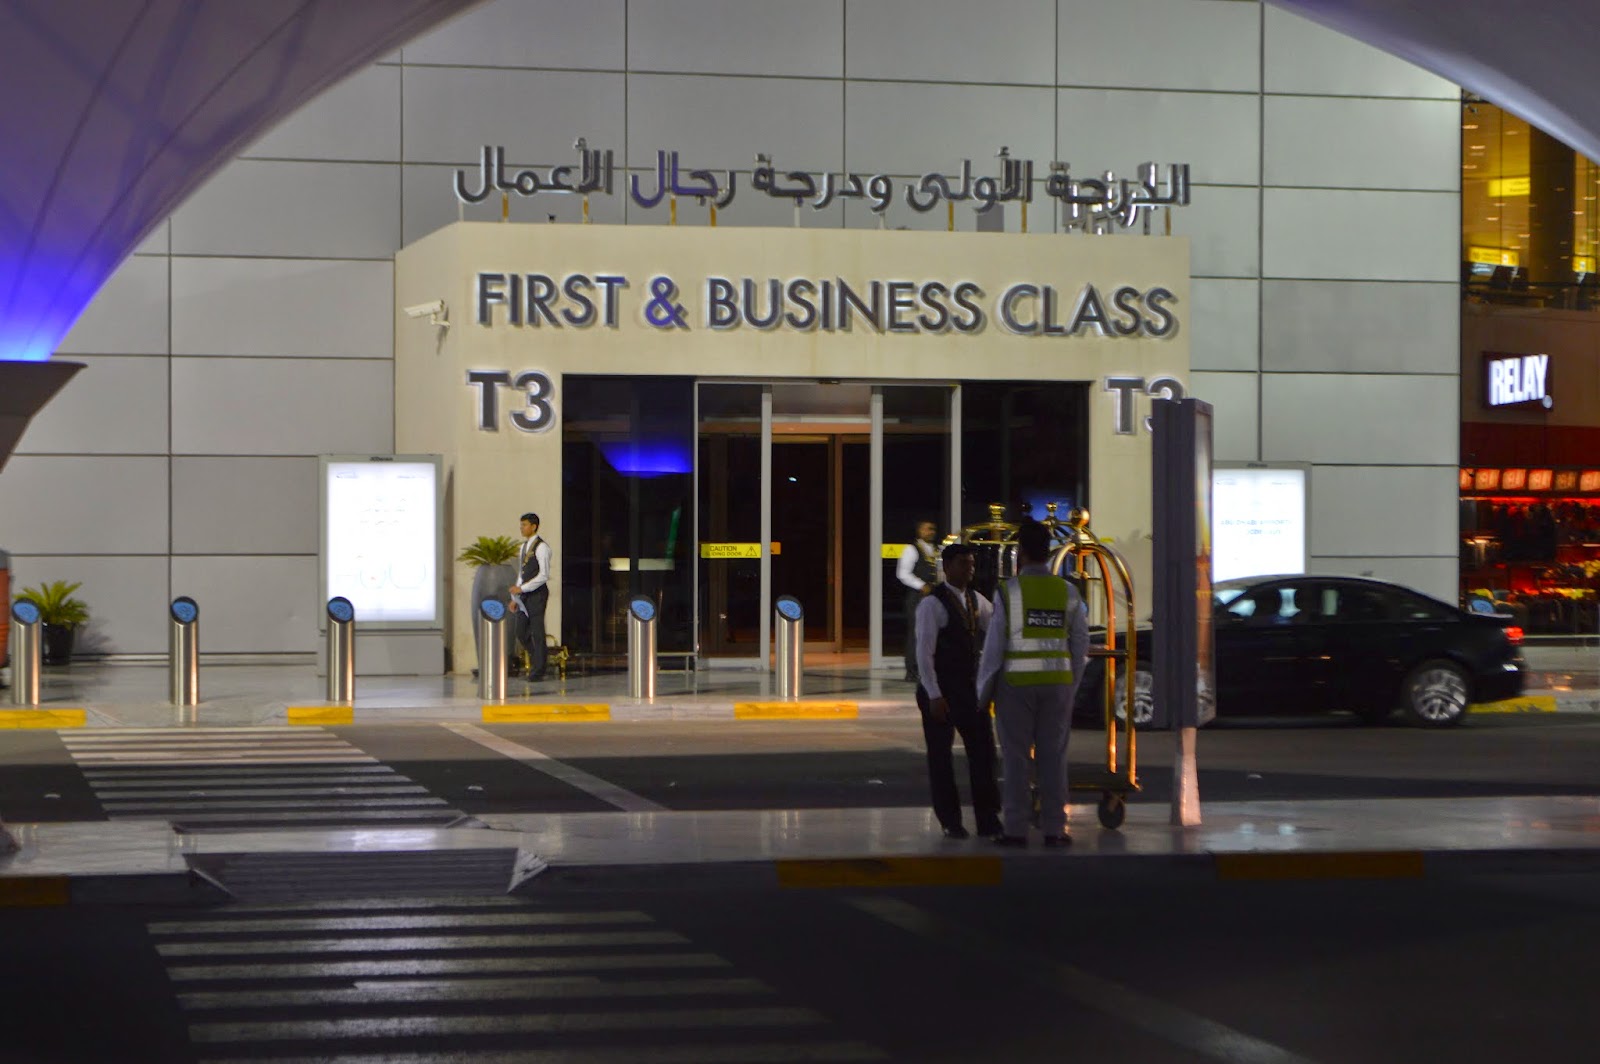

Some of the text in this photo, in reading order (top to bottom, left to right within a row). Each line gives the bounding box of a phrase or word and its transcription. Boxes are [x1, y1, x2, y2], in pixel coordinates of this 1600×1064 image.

[454, 137, 1192, 226] الدرجة الأولى ودرجة رجال الأعمال
[476, 272, 1179, 338] FIRST & BUSINESS CLASS
[466, 369, 556, 433] T3
[1489, 354, 1549, 406] RELAY
[1028, 618, 1064, 627] POLICE
